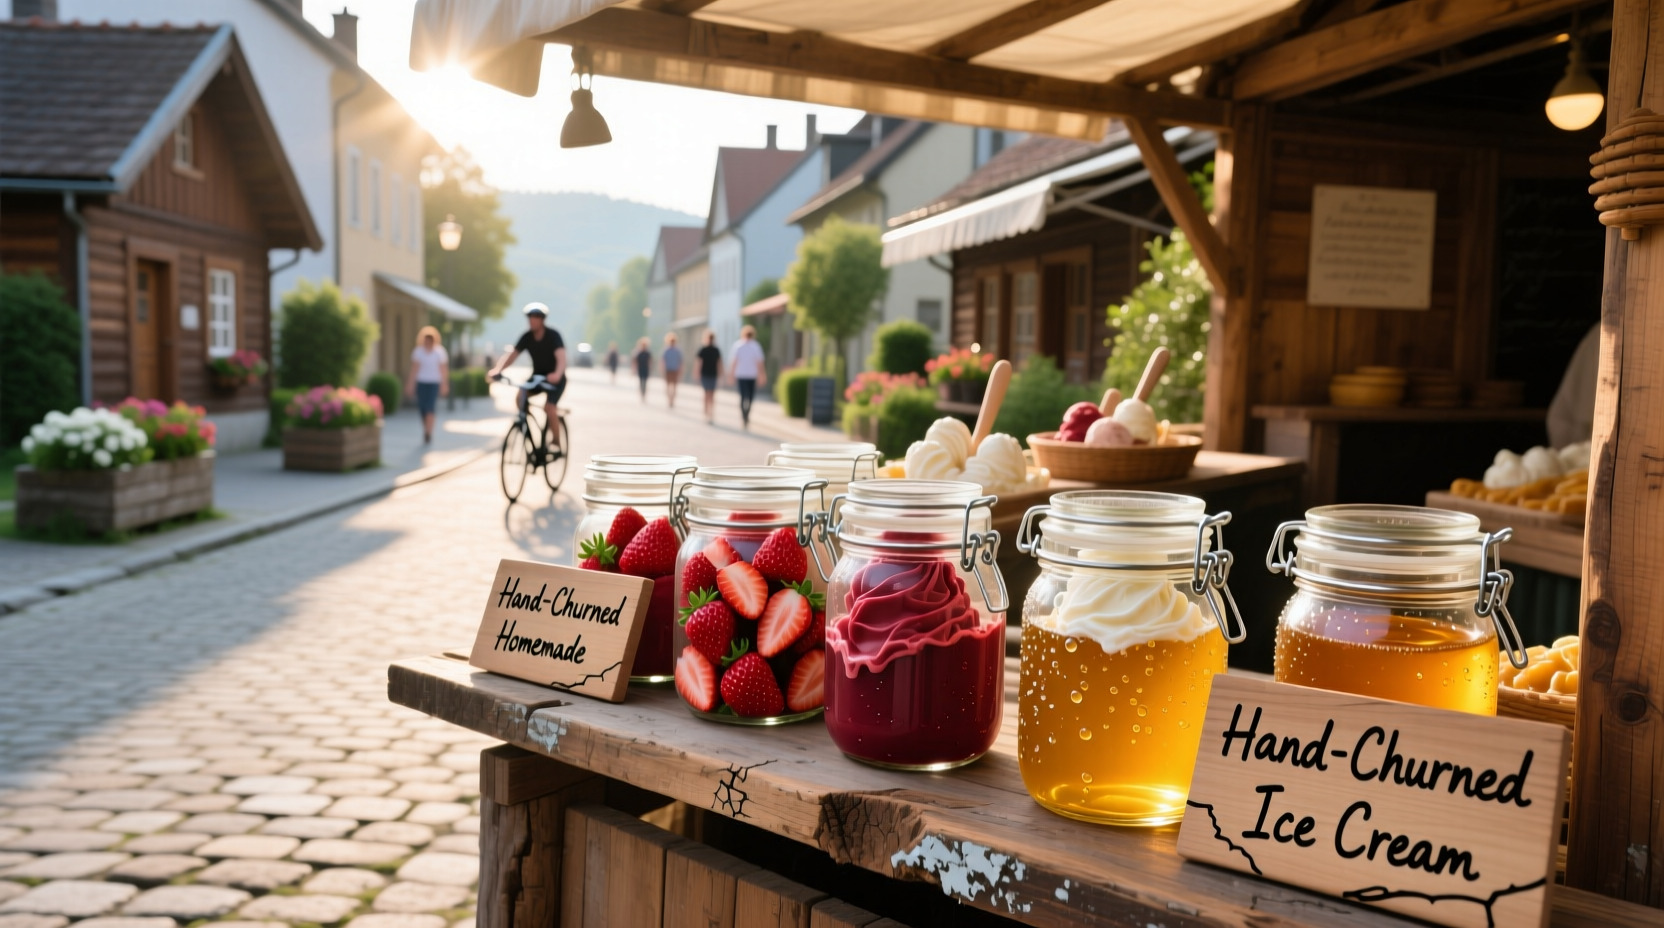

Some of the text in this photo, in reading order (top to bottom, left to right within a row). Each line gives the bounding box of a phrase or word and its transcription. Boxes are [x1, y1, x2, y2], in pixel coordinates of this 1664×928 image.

[498, 576, 627, 626] Hand-Churned
[494, 620, 586, 664] Homemade
[1222, 704, 1534, 807] Hand-Churned
[1242, 785, 1480, 881] Ice Cream
